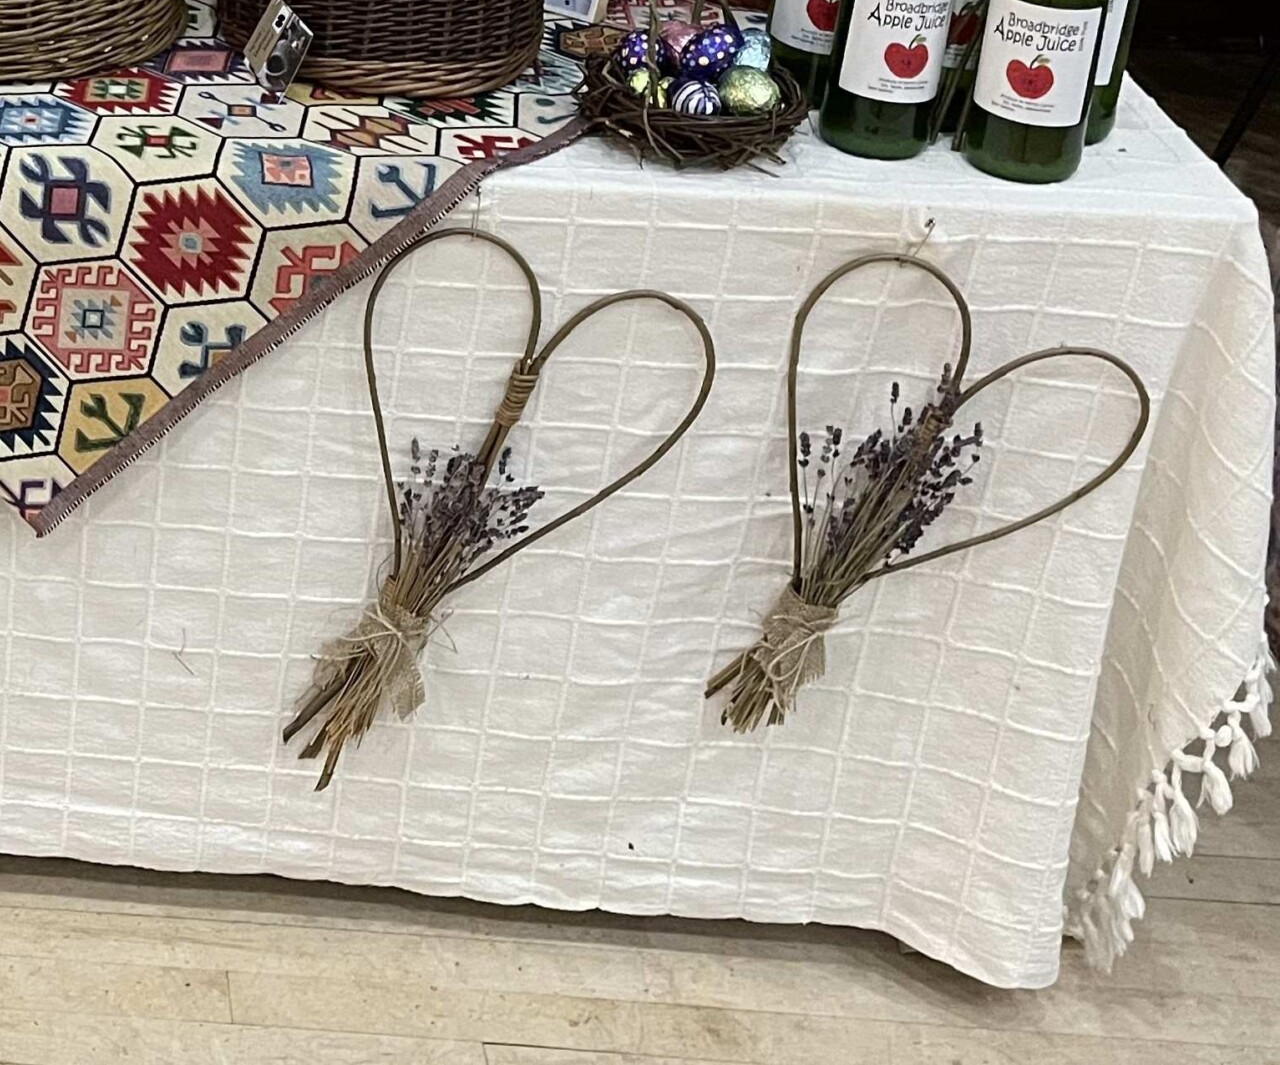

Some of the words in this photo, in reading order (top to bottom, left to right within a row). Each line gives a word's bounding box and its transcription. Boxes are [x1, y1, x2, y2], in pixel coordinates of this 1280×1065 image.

[867, 2, 913, 29] Apple
[915, 15, 946, 32] Juice
[1008, 12, 1080, 37] Broadbridge
[994, 16, 1034, 47] Apple
[1036, 34, 1077, 52] Juice
